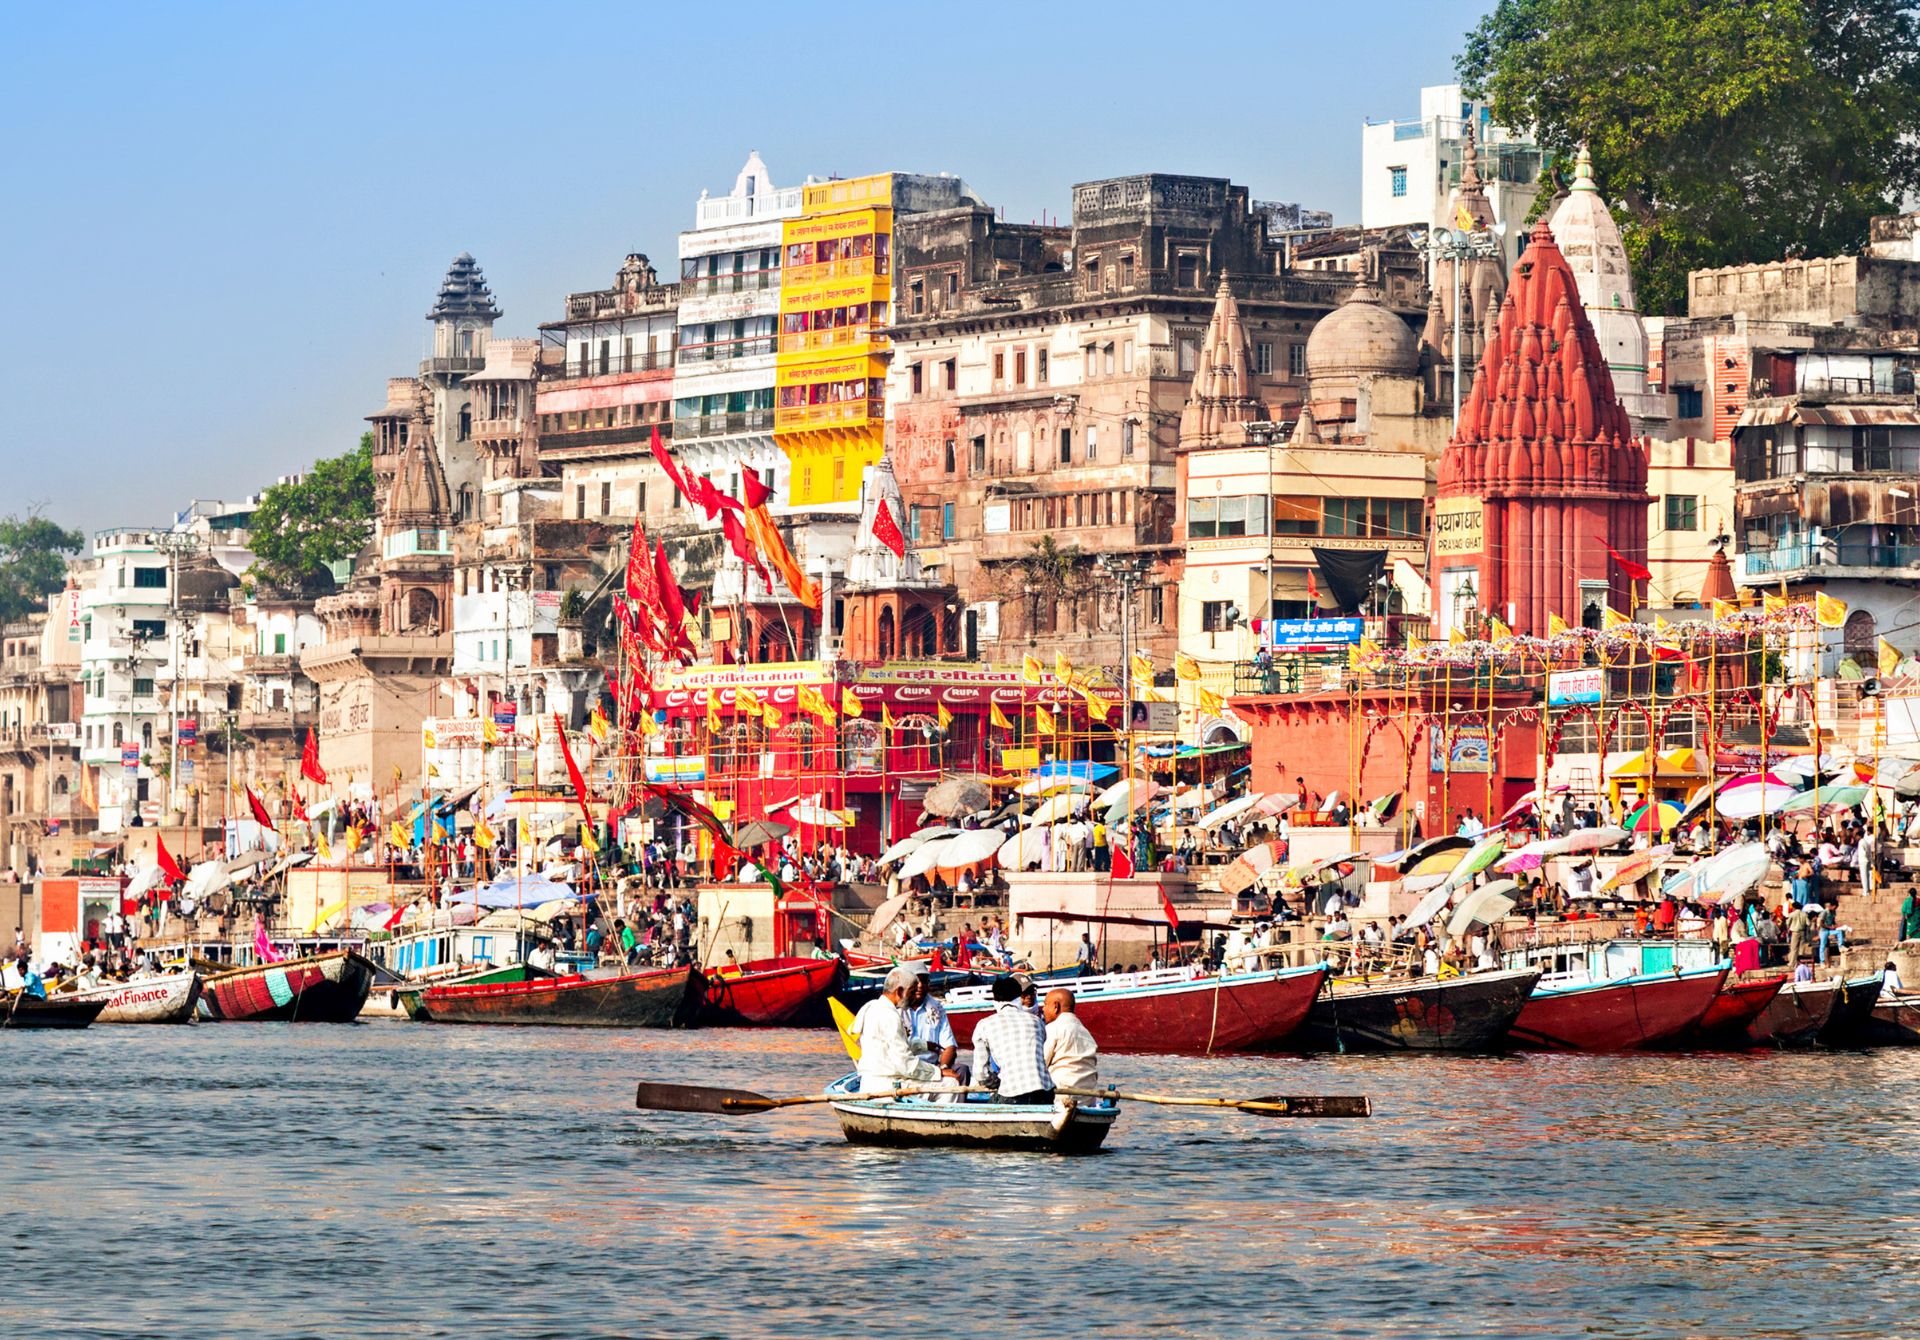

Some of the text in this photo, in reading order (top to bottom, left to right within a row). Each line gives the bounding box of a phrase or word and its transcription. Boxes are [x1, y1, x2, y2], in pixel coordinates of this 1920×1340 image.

[1438, 537, 1482, 551] PRAYAG GHAT
[70, 591, 80, 626] SITA
[856, 686, 884, 694] RUPA
[903, 687, 932, 695] RUPA
[951, 688, 980, 696] RUPA
[1000, 689, 1027, 697] RUPA
[124, 988, 168, 1005] Finance
